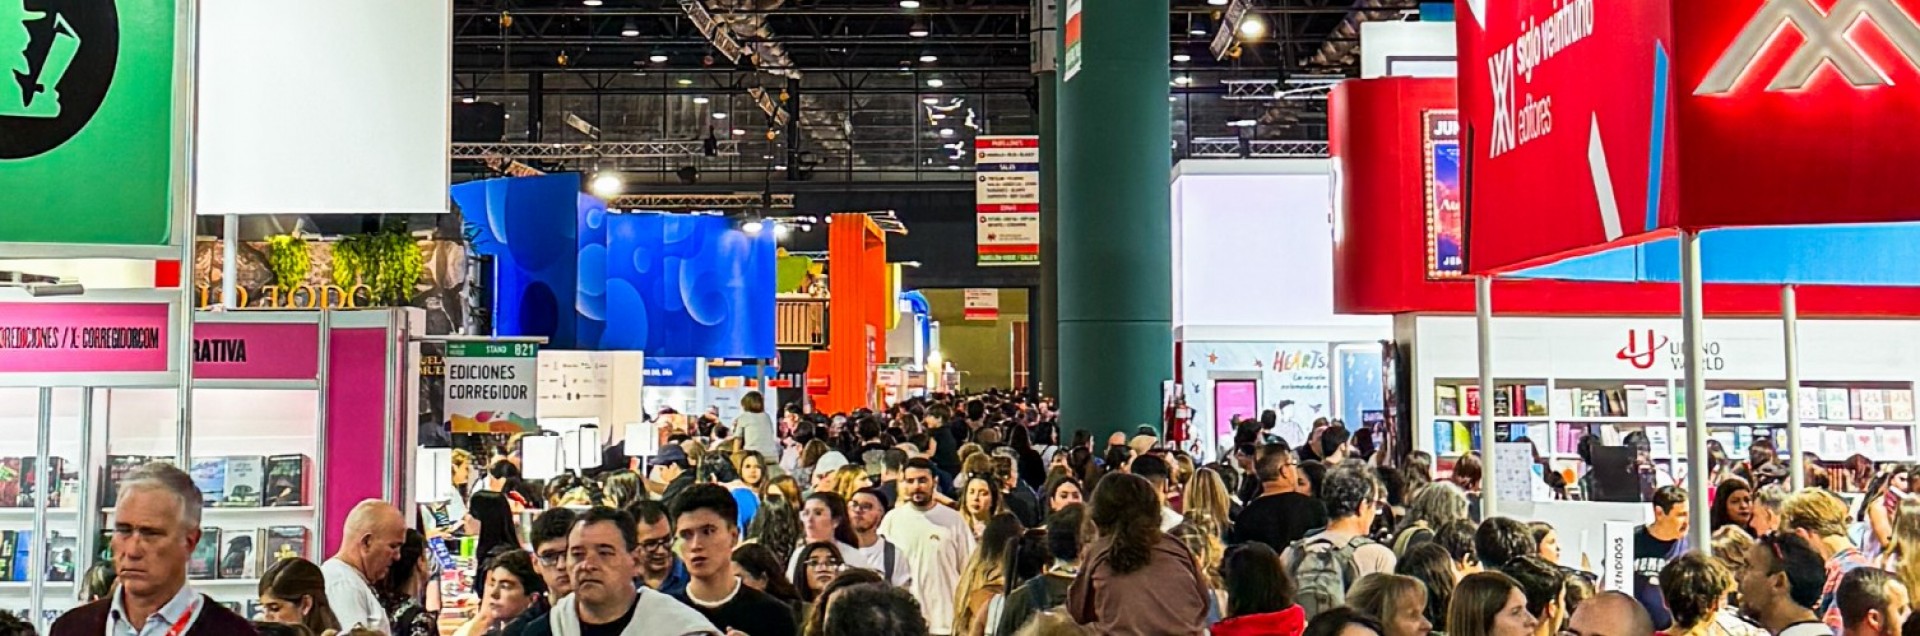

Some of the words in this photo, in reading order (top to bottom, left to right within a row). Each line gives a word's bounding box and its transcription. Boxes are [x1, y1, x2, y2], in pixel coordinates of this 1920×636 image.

[1516, 15, 1540, 84] siglo
[1518, 92, 1552, 145] editores
[514, 343, 534, 356] 821
[1669, 341, 1720, 355] UNO
[1273, 349, 1330, 373] HEARTS
[1671, 356, 1725, 371] WLD
[449, 364, 516, 380] EDICIONES
[449, 384, 529, 400] CORREGIDOR
